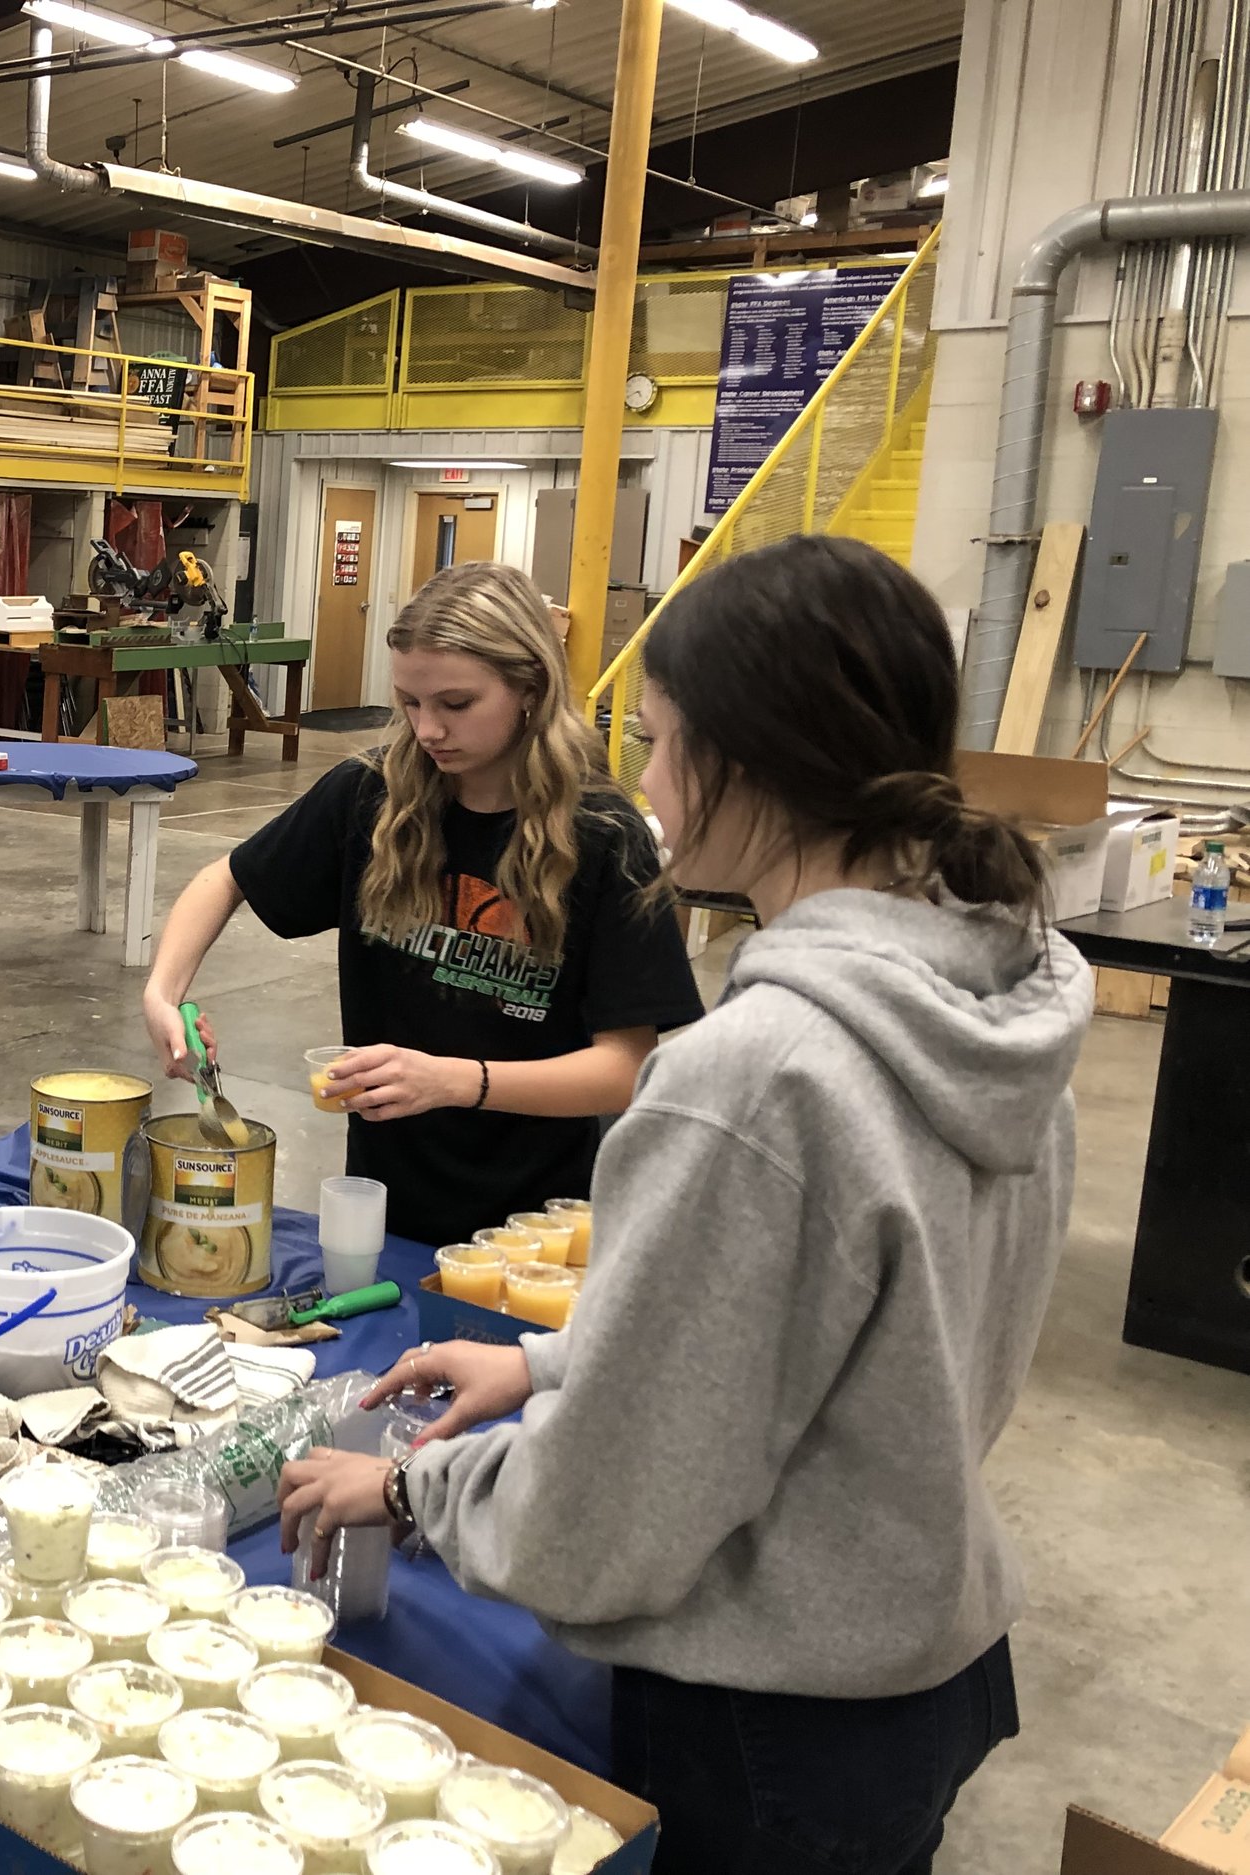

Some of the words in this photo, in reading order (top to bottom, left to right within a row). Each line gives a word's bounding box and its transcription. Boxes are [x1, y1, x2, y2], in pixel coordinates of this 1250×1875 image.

[140, 368, 166, 379] ANNA
[138, 380, 164, 393] FFA
[432, 966, 552, 1008] BASKETBALL
[502, 1003, 546, 1022] 2019
[39, 1104, 80, 1120] SUNSOURCE
[45, 1138, 68, 1149] MERIT
[36, 1149, 84, 1166] APPLESAUCE
[177, 1159, 233, 1172] SUNSOURCE
[190, 1196, 218, 1206] MERIT
[201, 1211, 247, 1221] MANZANA
